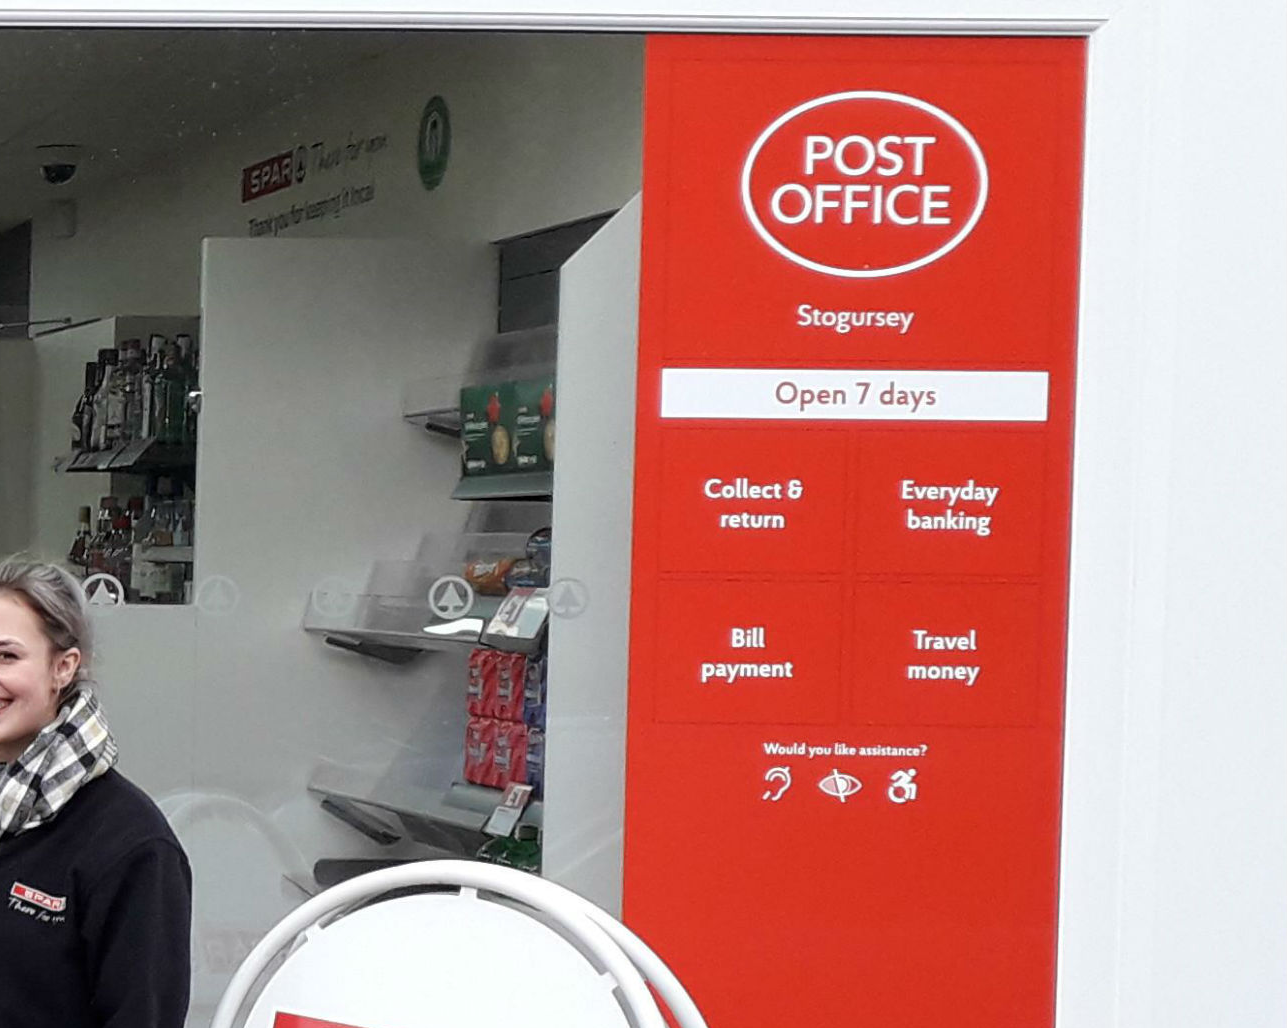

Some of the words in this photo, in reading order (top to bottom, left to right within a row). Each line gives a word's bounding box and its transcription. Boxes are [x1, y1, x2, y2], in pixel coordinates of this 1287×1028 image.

[805, 136, 935, 176] POST
[250, 157, 292, 195] SPAR
[771, 184, 950, 225] OFFICE
[798, 305, 914, 333] Stogursey
[776, 382, 846, 411] Open
[856, 383, 871, 405] 7
[880, 382, 936, 411] days
[705, 478, 781, 498] Collect
[788, 480, 803, 499] &
[902, 480, 998, 506] Everyday
[721, 513, 784, 528] return
[907, 509, 991, 536] banking
[732, 628, 764, 647] Bill
[913, 630, 976, 650] Travel
[702, 662, 793, 683] payment
[908, 666, 979, 685] money
[764, 743, 805, 755] Would
[808, 745, 831, 758] you
[834, 744, 856, 755] like
[859, 744, 927, 756] assistance?
